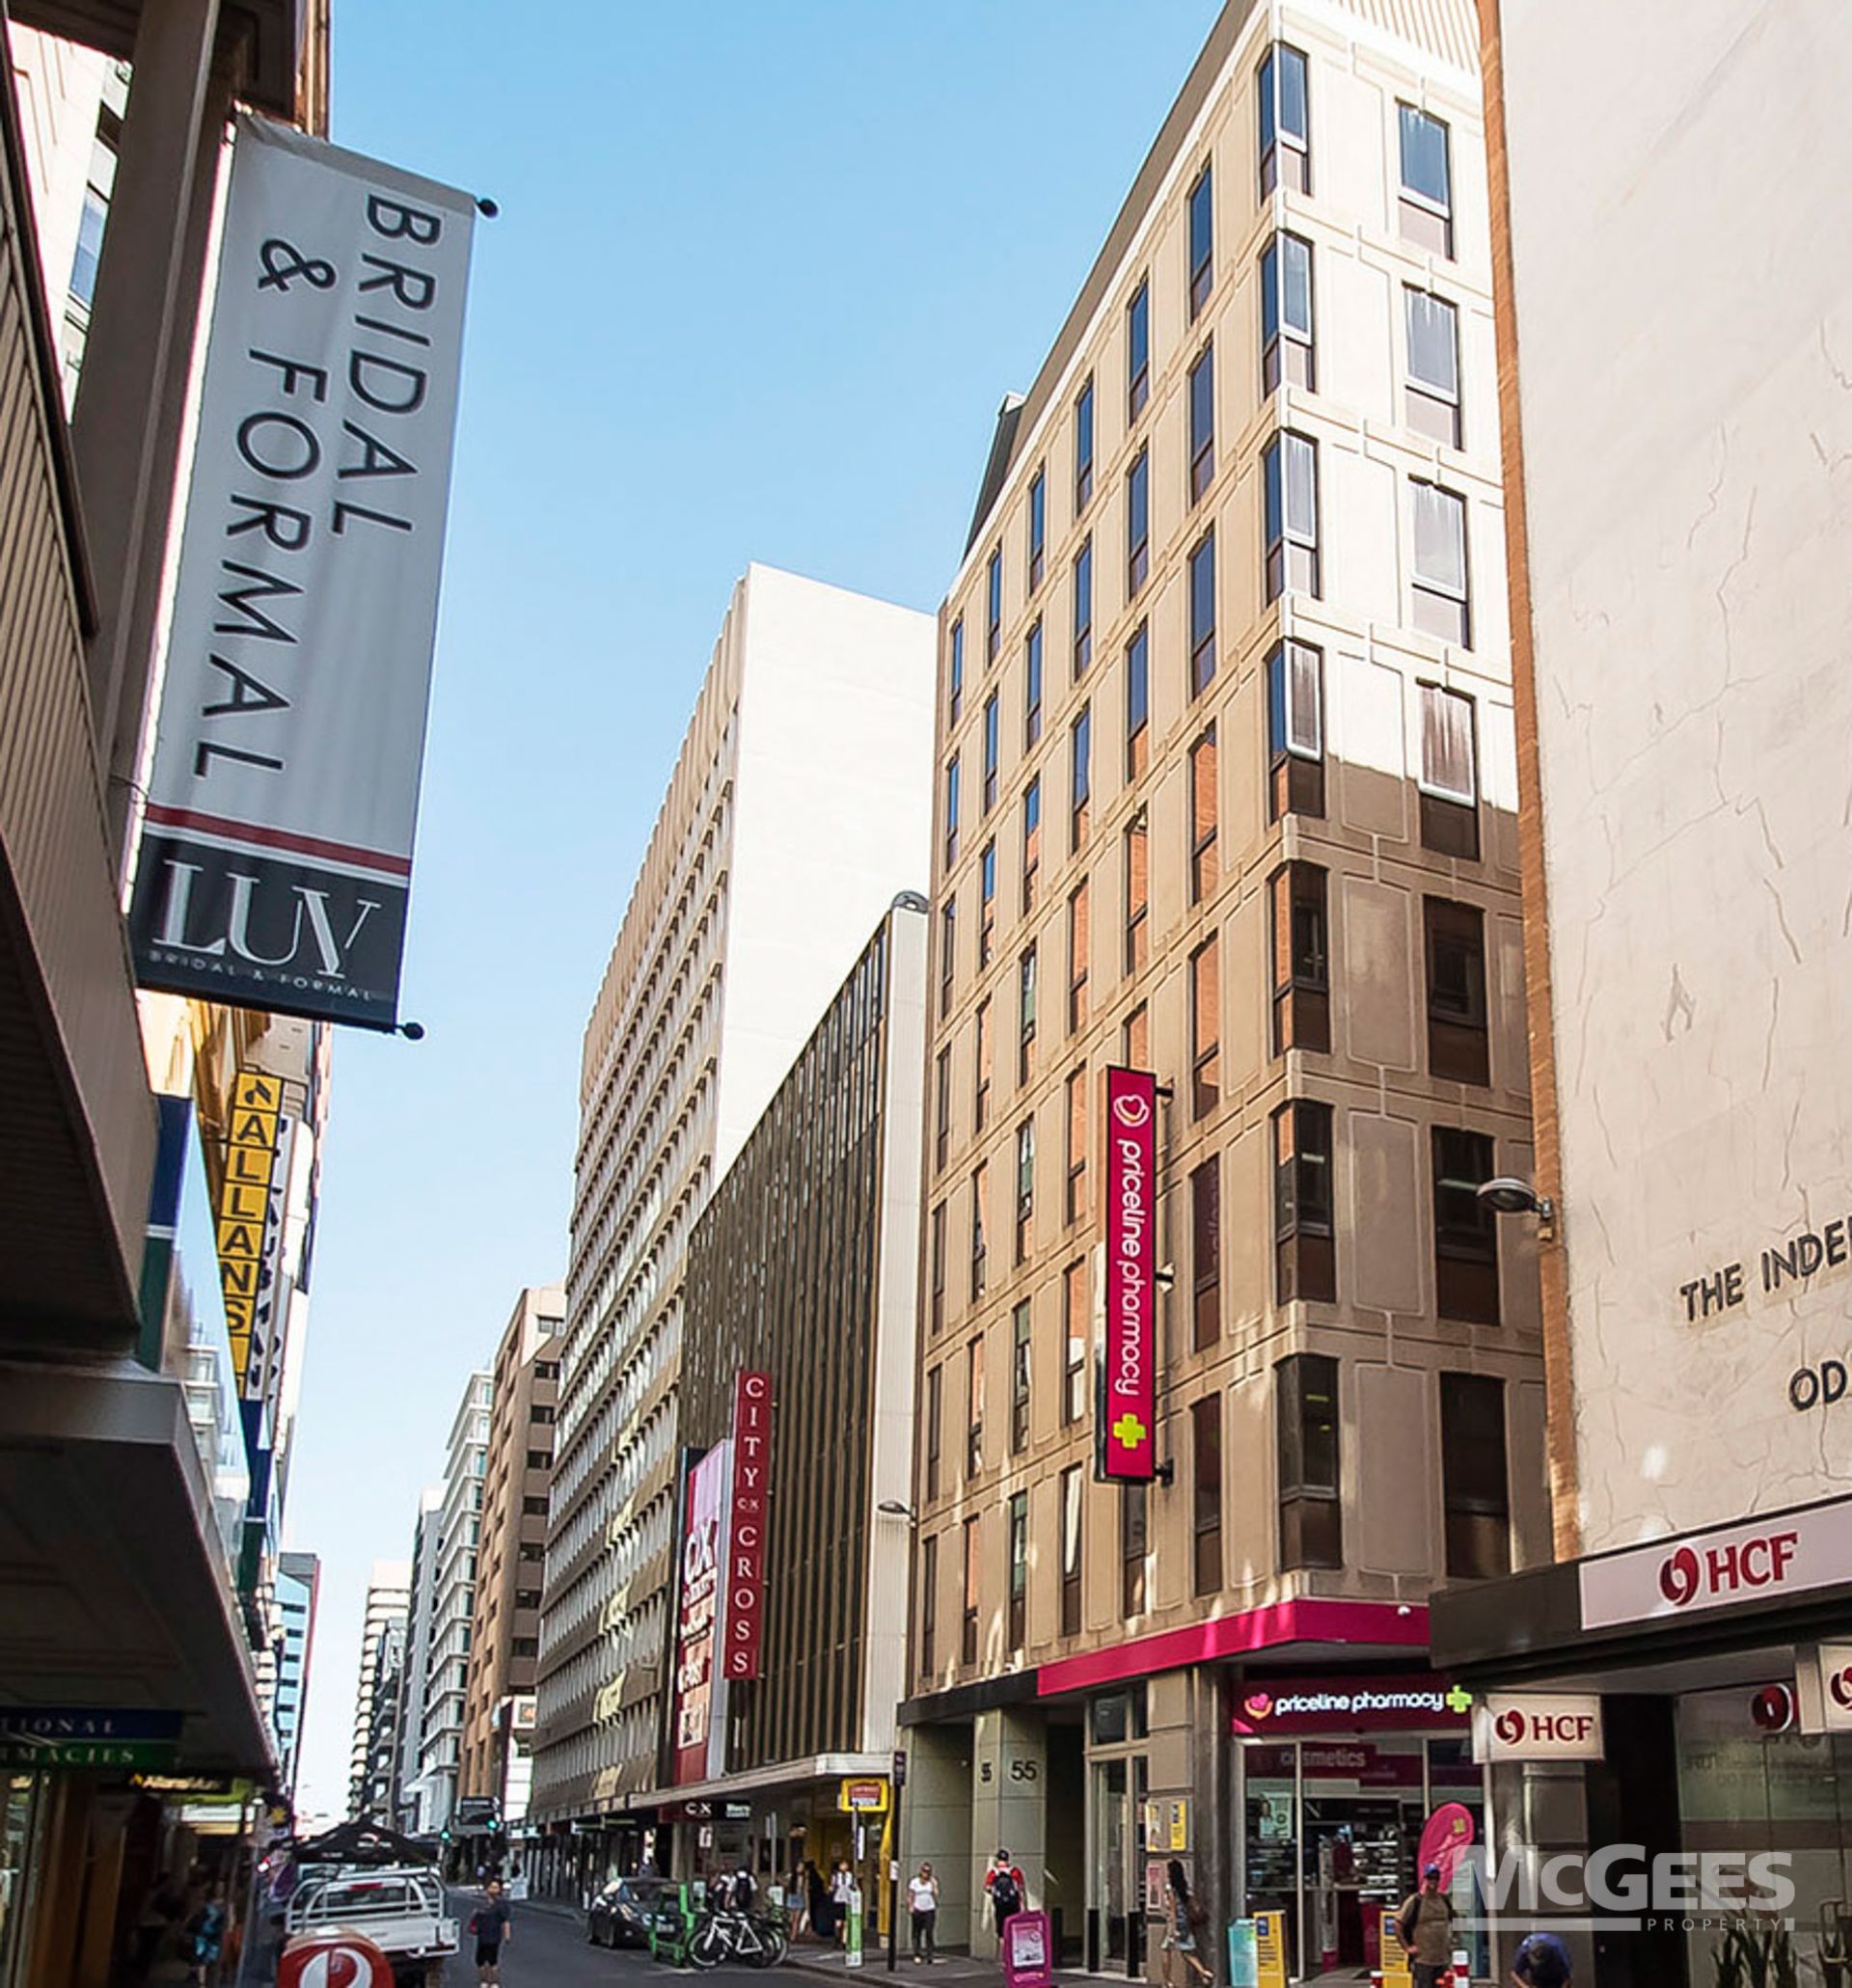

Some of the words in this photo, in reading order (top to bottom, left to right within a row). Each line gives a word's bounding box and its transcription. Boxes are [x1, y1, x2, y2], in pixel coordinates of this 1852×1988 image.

[256, 238, 337, 292] &
[331, 192, 441, 537] BRIDAL
[194, 346, 328, 778] FORMAL
[152, 858, 382, 979] LUV
[149, 950, 235, 976] BRIDAL
[252, 969, 264, 981] &
[280, 973, 373, 1001] FORMAL
[223, 1114, 267, 1330] ALLANS
[1117, 1138, 1146, 1258] priceline
[1679, 1263, 1744, 1322] THE
[1760, 1215, 1852, 1292] INDE
[1114, 1259, 1147, 1396] pharmacy
[742, 1376, 765, 1487] CITY
[732, 1525, 757, 1674] CROSS
[1705, 1532, 1797, 1593] HCF
[1274, 1694, 1349, 1716] priceline
[1351, 1692, 1444, 1714] pharmacy
[1531, 1715, 1593, 1741] HCF
[1011, 1760, 1037, 1781] 55
